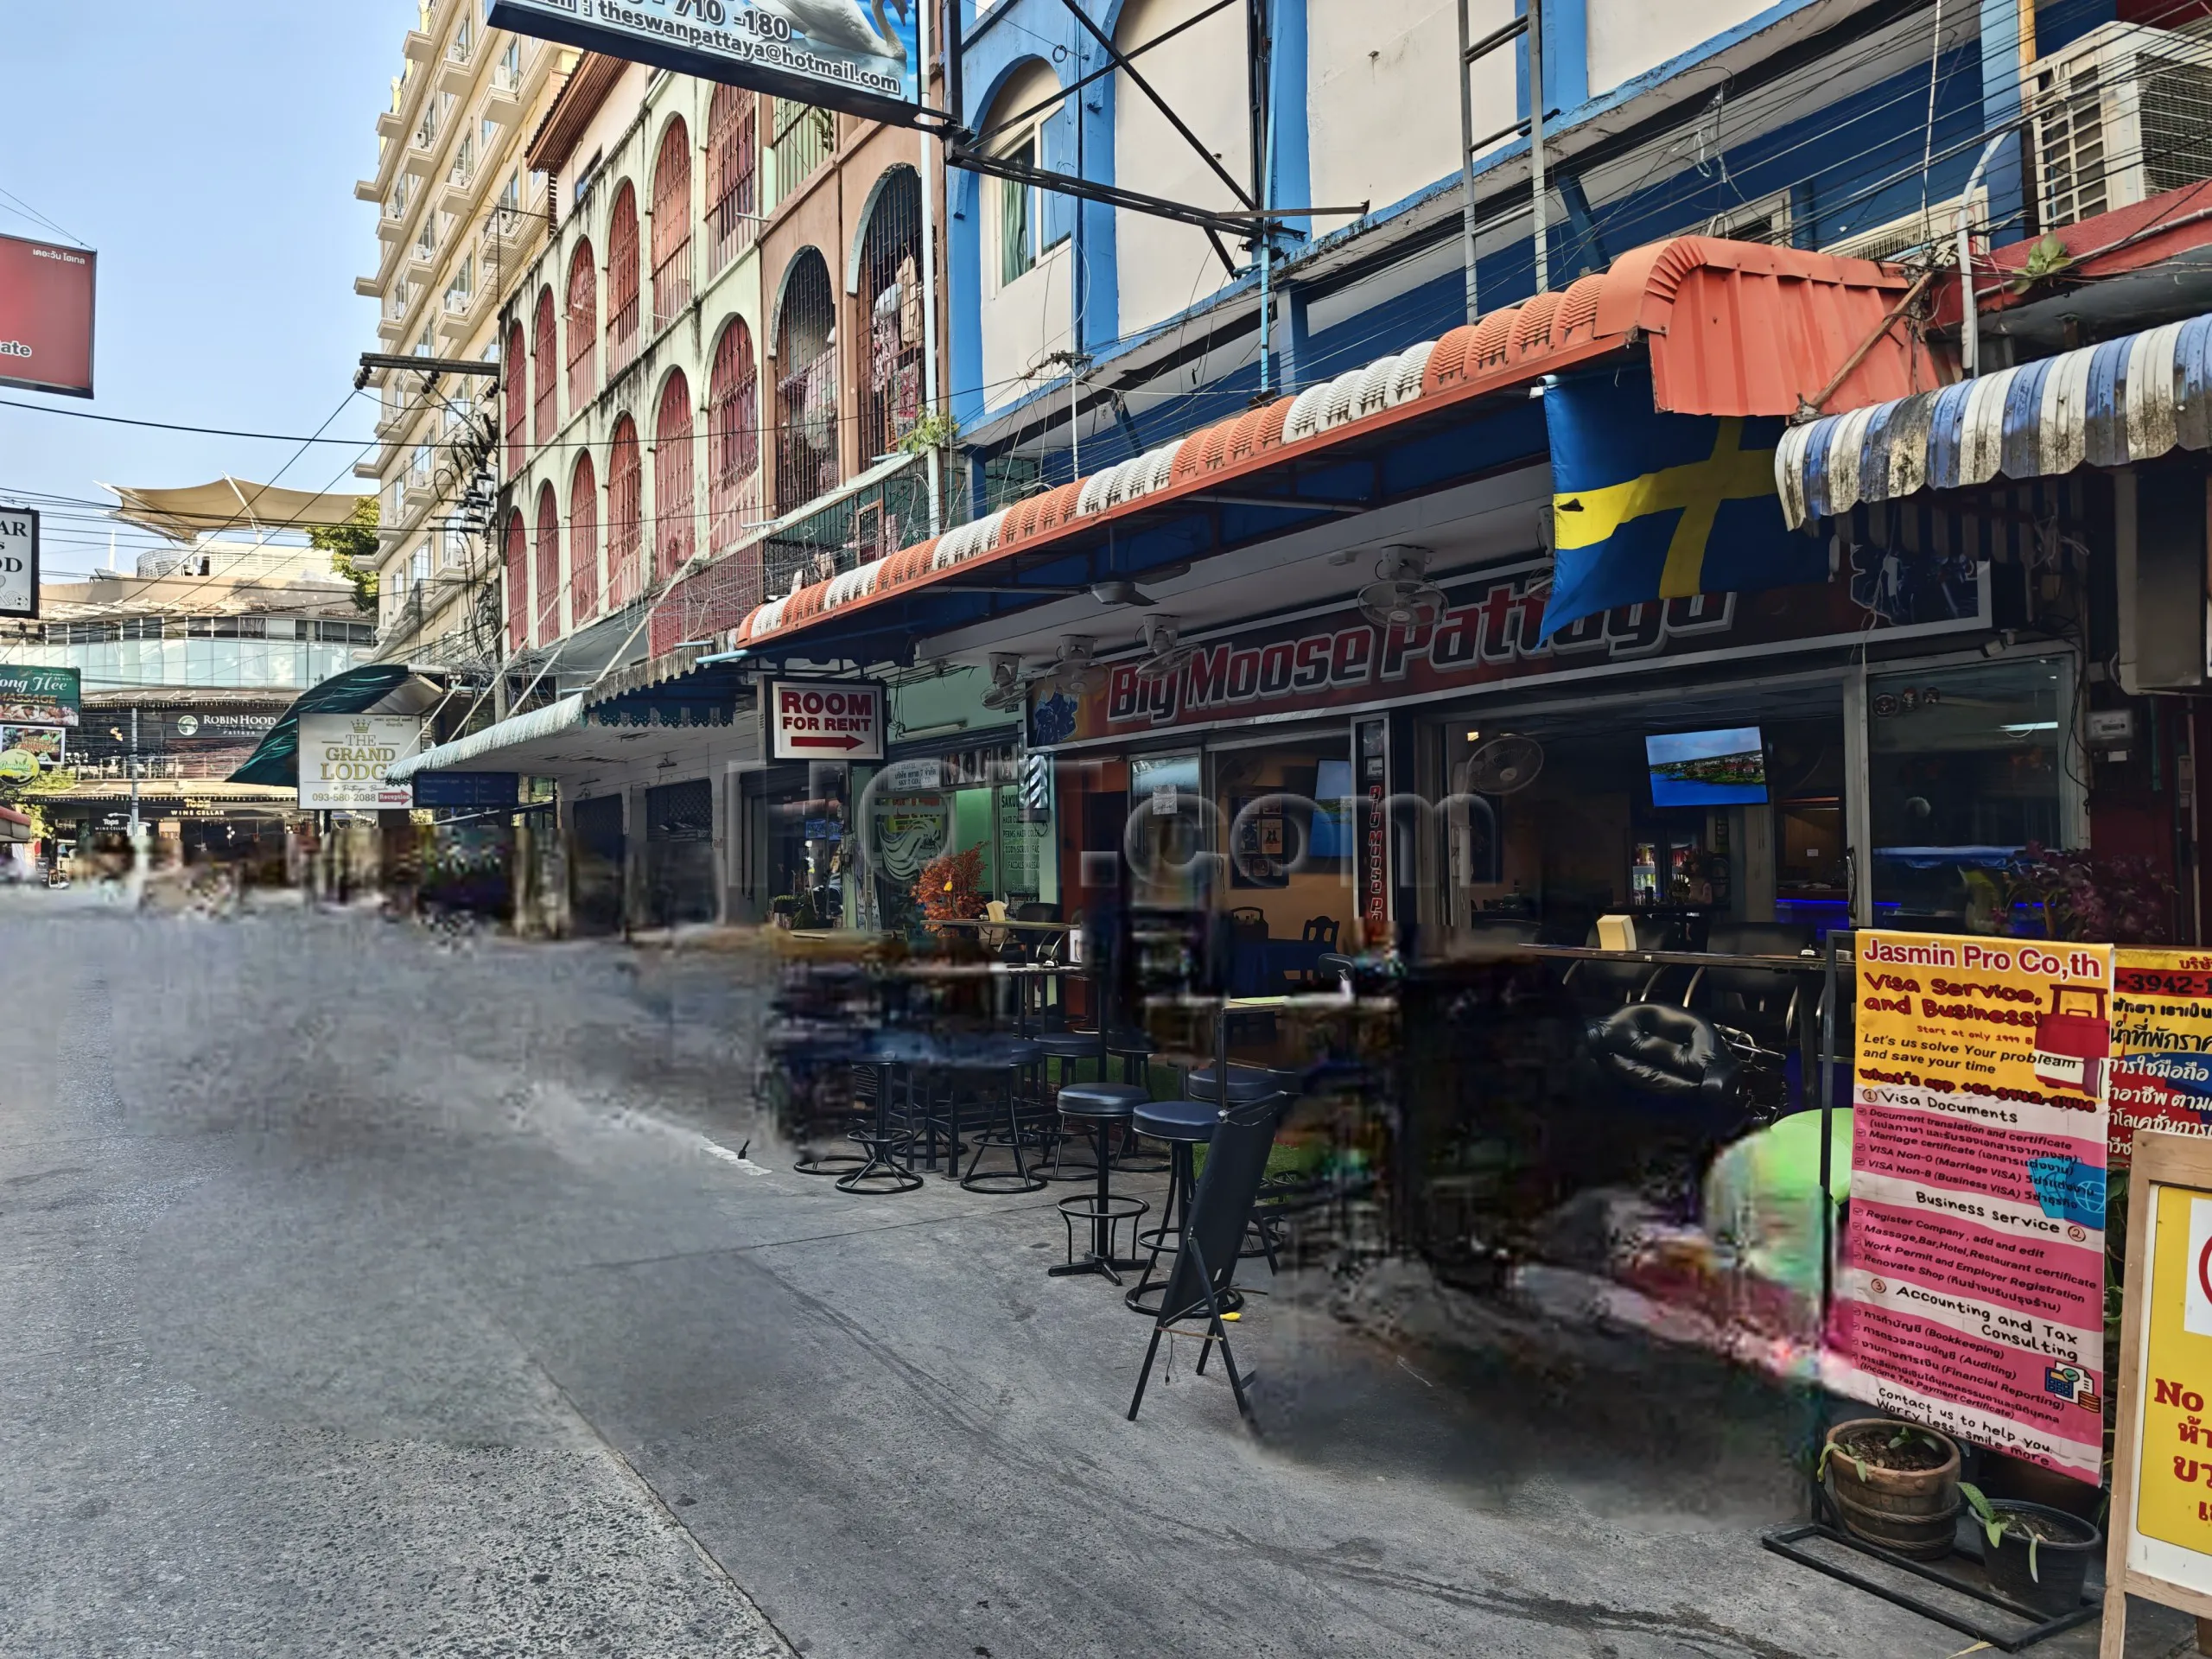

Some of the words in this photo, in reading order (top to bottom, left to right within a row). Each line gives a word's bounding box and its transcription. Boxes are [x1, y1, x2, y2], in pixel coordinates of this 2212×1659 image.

[598, 2, 899, 92] theswanpattaya@hotmail.com
[0, 340, 32, 358] ate
[0, 557, 22, 572] D
[1185, 626, 1376, 706] Moose
[781, 691, 872, 715] ROOM
[203, 715, 238, 725] ROBIN
[240, 715, 276, 726] HOOD
[783, 716, 819, 730] FOR
[824, 718, 872, 731] RENT
[346, 734, 376, 746] THE
[325, 747, 396, 761] GRAND
[321, 762, 393, 780] LODG
[312, 793, 376, 802] 093-580-2088
[103, 818, 119, 827] Tops
[1864, 938, 1956, 967] Jasmin
[1963, 944, 2012, 970] Pro
[2018, 949, 2101, 980] Co,th
[2179, 957, 2212, 971] บริษั
[1864, 971, 1921, 993] Visa
[2114, 973, 2212, 995] -3942-1
[1864, 995, 1911, 1015] and
[1916, 1025, 1946, 1035] Start
[1968, 1031, 1991, 1041] only
[1863, 1049, 1888, 1059] and
[1891, 1052, 1924, 1064] save
[1927, 1057, 1961, 1070] your
[1965, 1060, 1997, 1074] time
[1864, 1033, 1896, 1046] Let's
[1901, 1039, 1917, 1048] us
[1921, 1041, 1959, 1053] solve
[1964, 1044, 1997, 1058] Your
[1999, 1052, 2076, 1069] probleam
[1880, 1090, 1921, 1106] Visa
[1927, 1096, 2018, 1123] Documents
[1869, 1109, 1925, 1123] Document
[1927, 1117, 1985, 1135] translation
[1986, 1128, 2006, 1139] and
[2009, 1134, 2072, 1150] certificate
[1869, 1129, 1918, 1146] Marriage
[1921, 1139, 1976, 1156] certificate
[1869, 1144, 1894, 1156] VISA
[1897, 1150, 1933, 1163] Non-O
[1935, 1156, 1988, 1174] (Marriage
[1991, 1168, 2022, 1184] VISA)
[1868, 1160, 1893, 1171] VISA
[1896, 1166, 1932, 1178] Non-B
[1934, 1171, 1988, 1190] (Business
[1990, 1184, 2021, 1199] VISA)
[1916, 1191, 1985, 1217] Business
[1992, 1211, 2061, 1234] service
[1866, 1210, 1913, 1226] Register
[1916, 1220, 1965, 1240] Company
[1973, 1235, 1993, 1246] add
[1996, 1242, 2016, 1252] and
[2018, 1248, 2045, 1258] edit
[1864, 1254, 1916, 1274] Renovate
[1918, 1267, 1945, 1281] Shop
[1864, 1239, 1892, 1253] Work
[1895, 1246, 1934, 1262] Permit
[1935, 1257, 1955, 1268] and
[1956, 1262, 2008, 1283] Employer
[2010, 1276, 2085, 1304] Registration
[2034, 1267, 2098, 1290] certificate
[1896, 1286, 1991, 1322] Accounting
[1998, 1316, 2032, 1333] and
[2043, 1325, 2078, 1345] Tax
[1924, 1327, 2005, 1359] (Bookkeeping)
[1981, 1324, 2079, 1363] Consulting
[1959, 1354, 2017, 1381] (Auditing)
[1859, 1362, 1896, 1380] (Income
[1916, 1382, 1959, 1401] Payment
[1960, 1395, 2015, 1420] Certificate)
[1942, 1364, 1999, 1389] (Financial
[2000, 1382, 2065, 1412] Reporting)
[2154, 1377, 2204, 1412] No
[1876, 1397, 1921, 1423] Worry
[1965, 1430, 2004, 1450] smile
[1878, 1387, 1932, 1414] Contact
[1939, 1409, 1954, 1421] us
[1960, 1414, 1976, 1427] to
[1982, 1421, 2016, 1442] help
